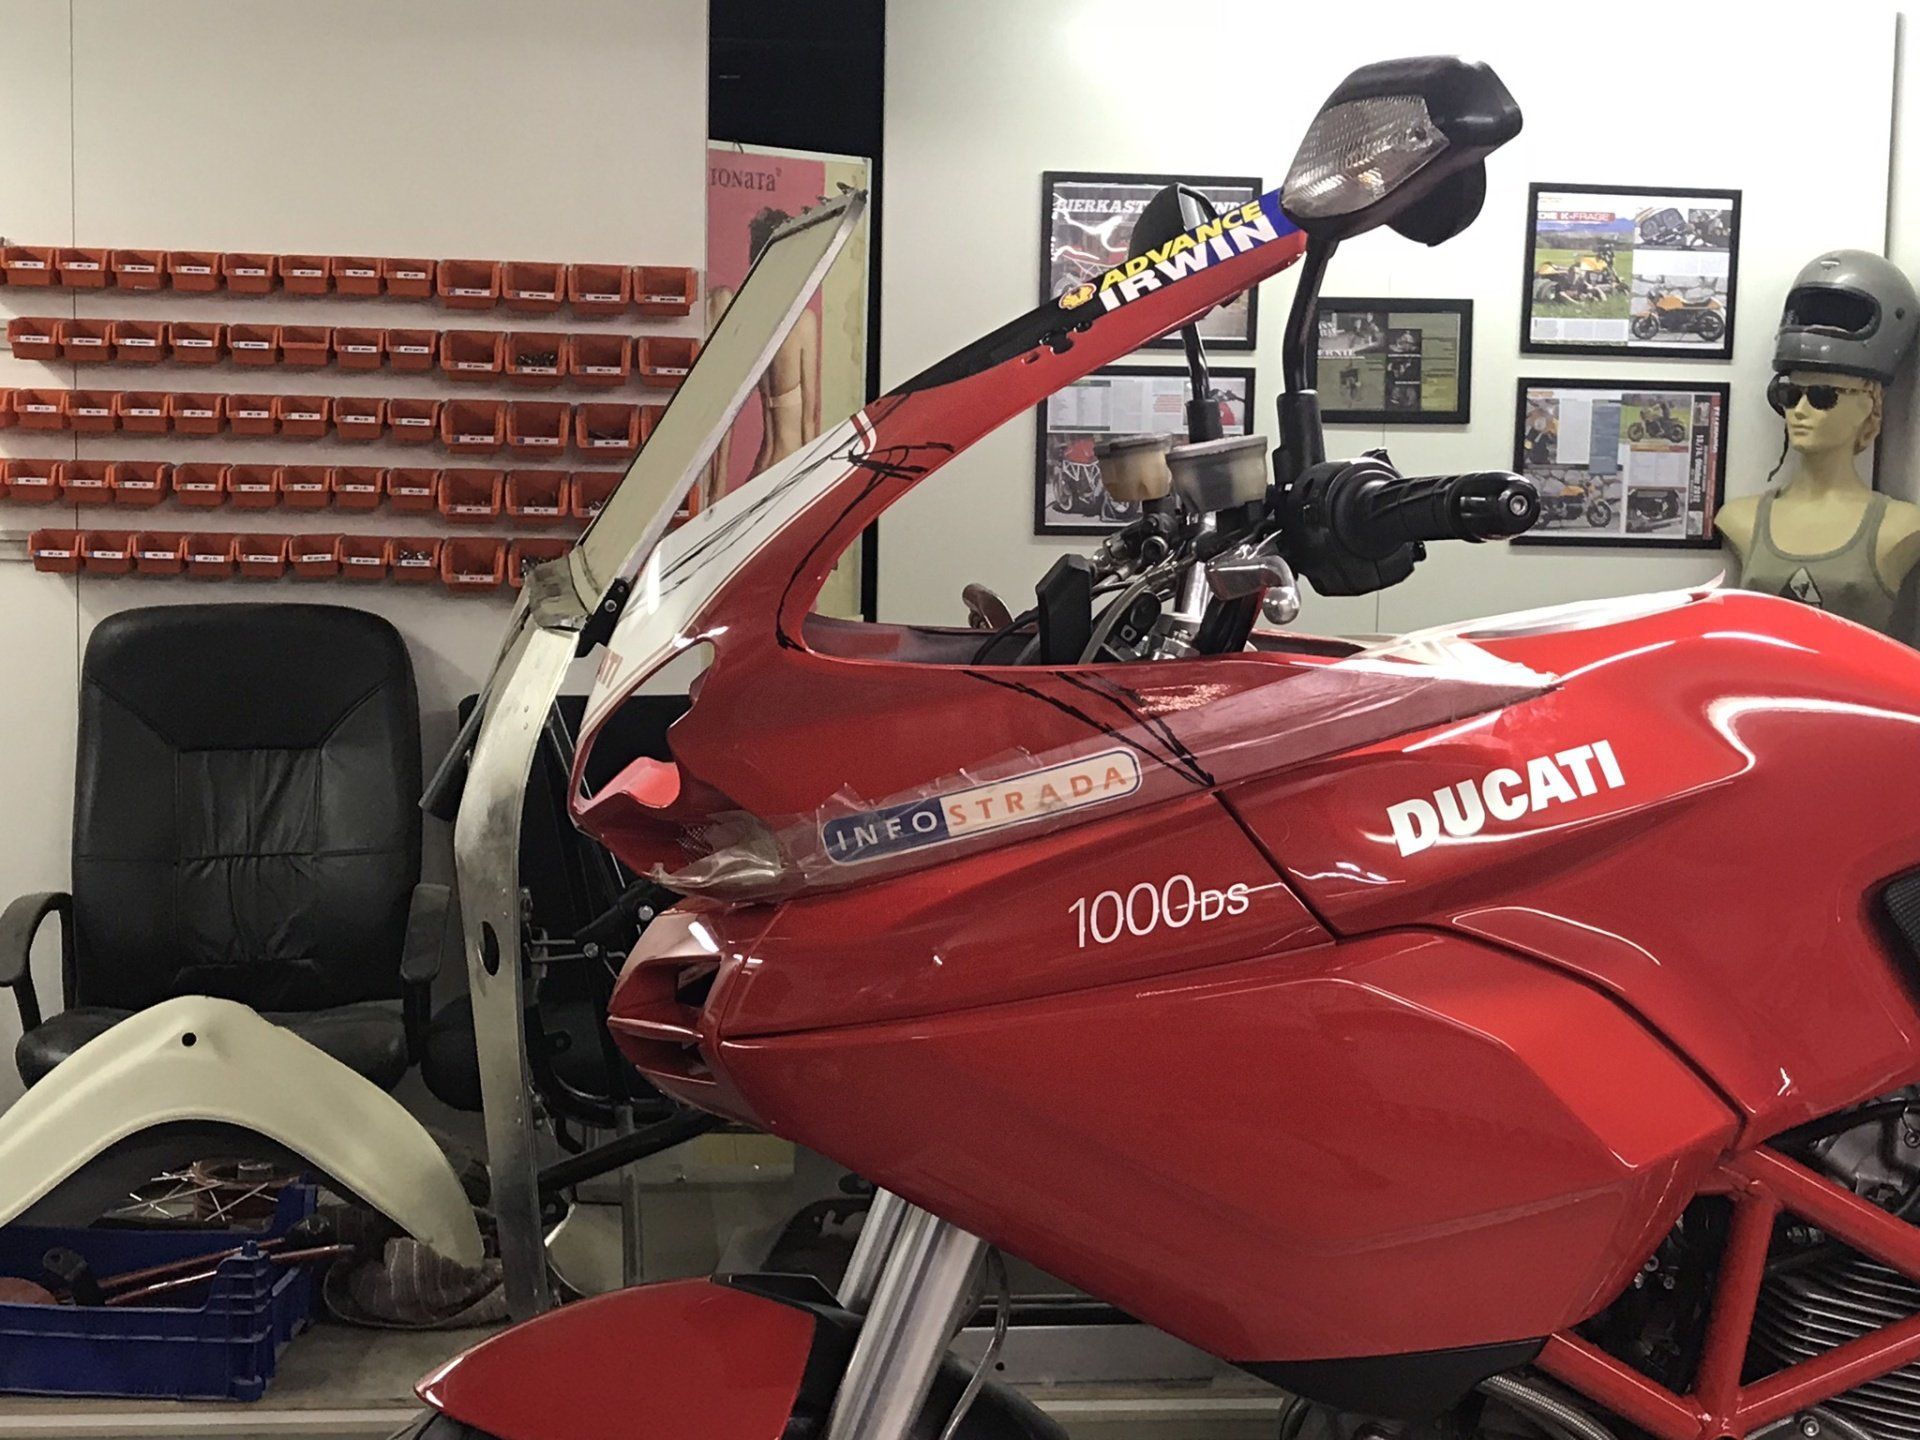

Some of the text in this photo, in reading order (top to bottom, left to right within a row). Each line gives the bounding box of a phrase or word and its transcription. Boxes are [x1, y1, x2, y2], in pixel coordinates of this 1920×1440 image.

[1057, 199, 1149, 214] BIERKAST
[1100, 200, 1263, 292] ADVANCE
[1099, 214, 1279, 312] IRWIN
[1386, 739, 1626, 858] DUCATI
